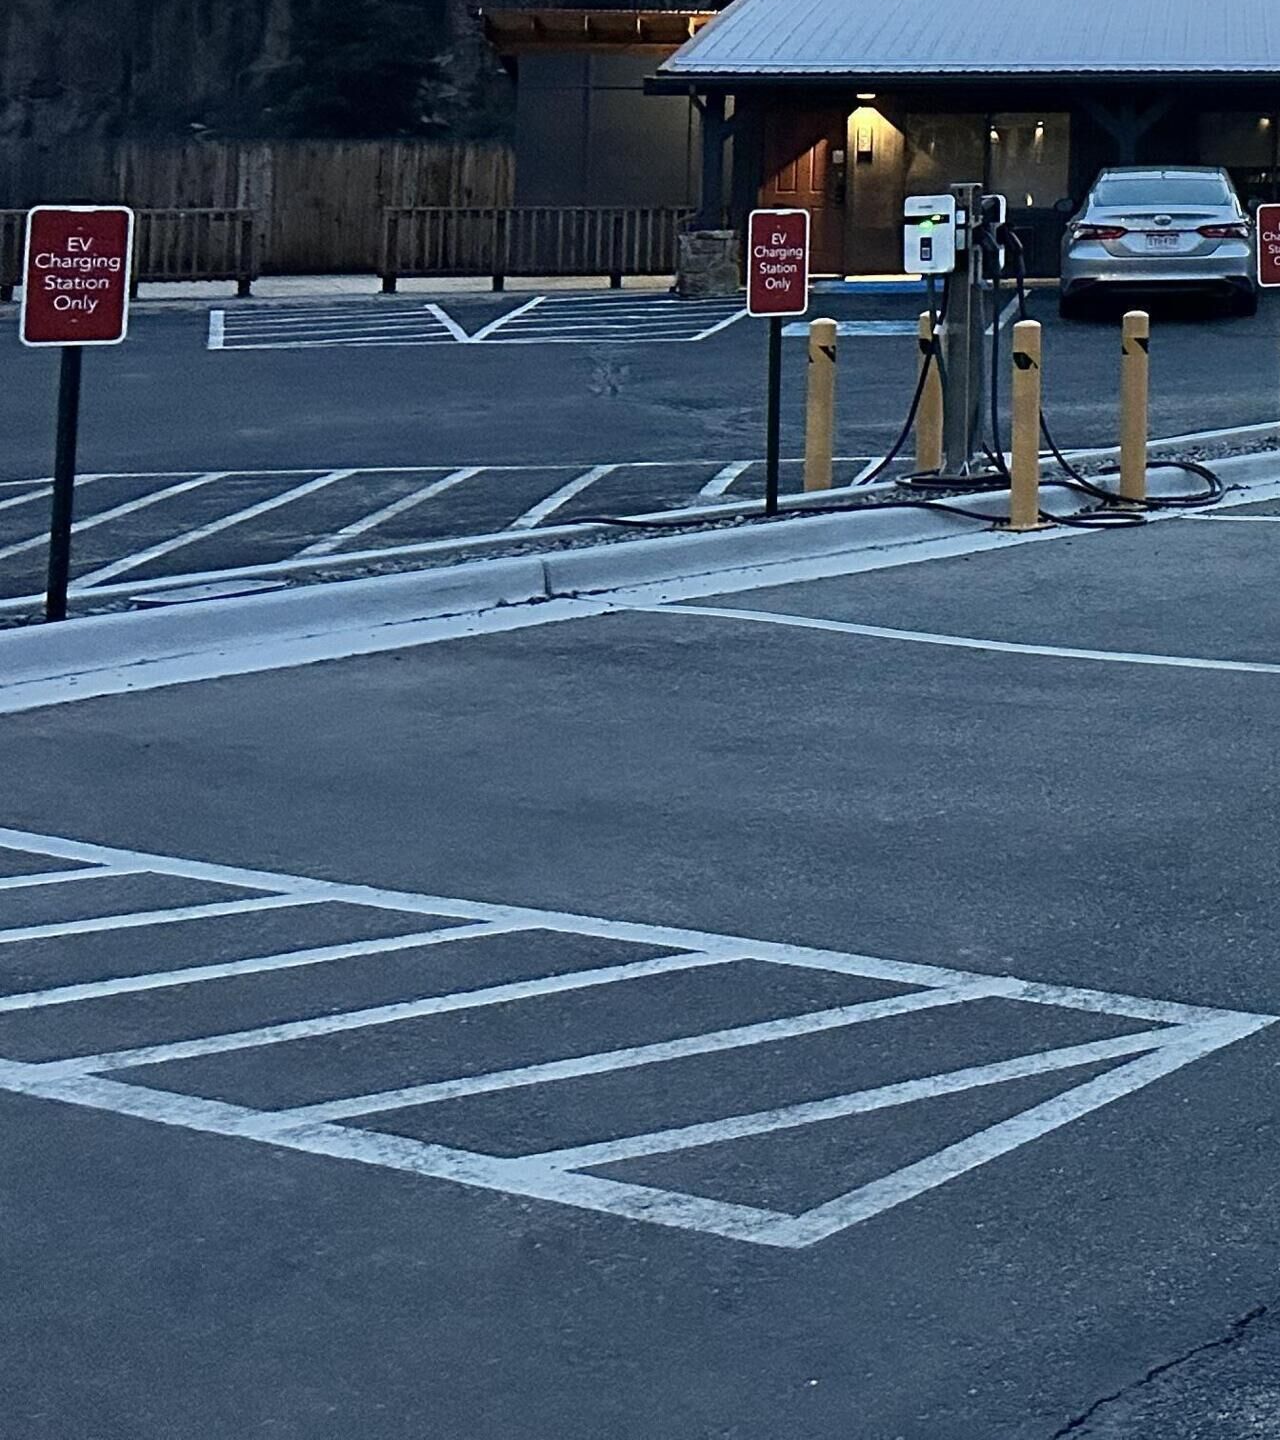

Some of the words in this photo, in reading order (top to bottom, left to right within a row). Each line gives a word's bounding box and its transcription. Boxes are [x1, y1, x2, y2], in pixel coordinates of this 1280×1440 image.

[67, 237, 93, 252] EV
[771, 232, 787, 245] EV
[754, 245, 804, 260] Charging
[35, 253, 121, 272] Charging
[759, 262, 797, 274] Station
[44, 275, 110, 290] Station
[765, 277, 791, 292] Only
[53, 295, 99, 313] Only
